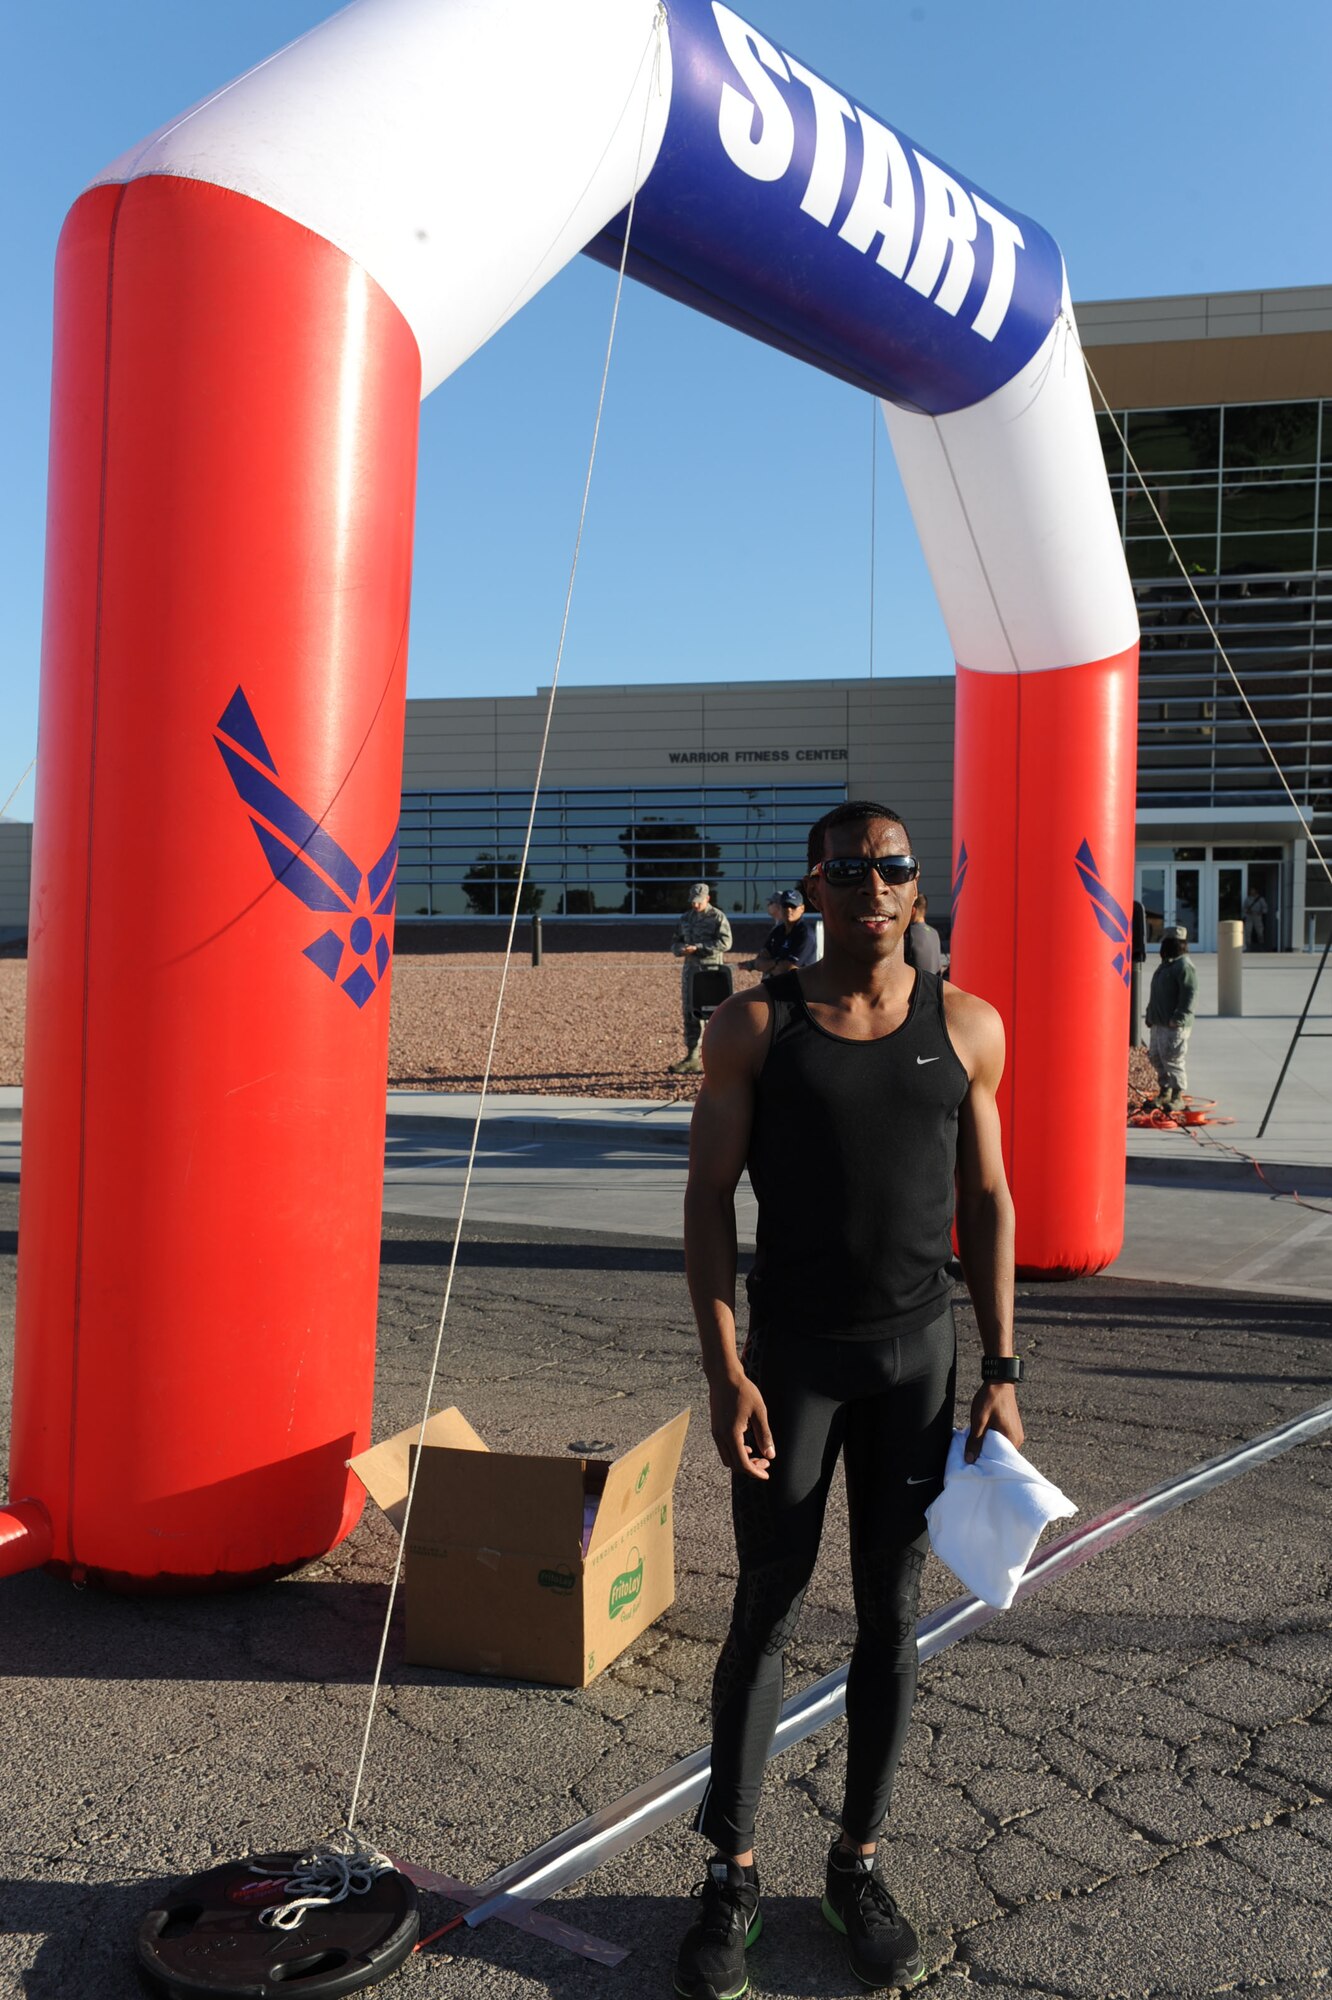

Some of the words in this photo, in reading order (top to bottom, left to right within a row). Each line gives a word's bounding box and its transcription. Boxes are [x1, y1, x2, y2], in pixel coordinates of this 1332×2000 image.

[712, 1, 1025, 342] START
[669, 752, 728, 763] WARRIOR
[735, 750, 789, 762] FITNESS
[795, 749, 848, 761] CENTER
